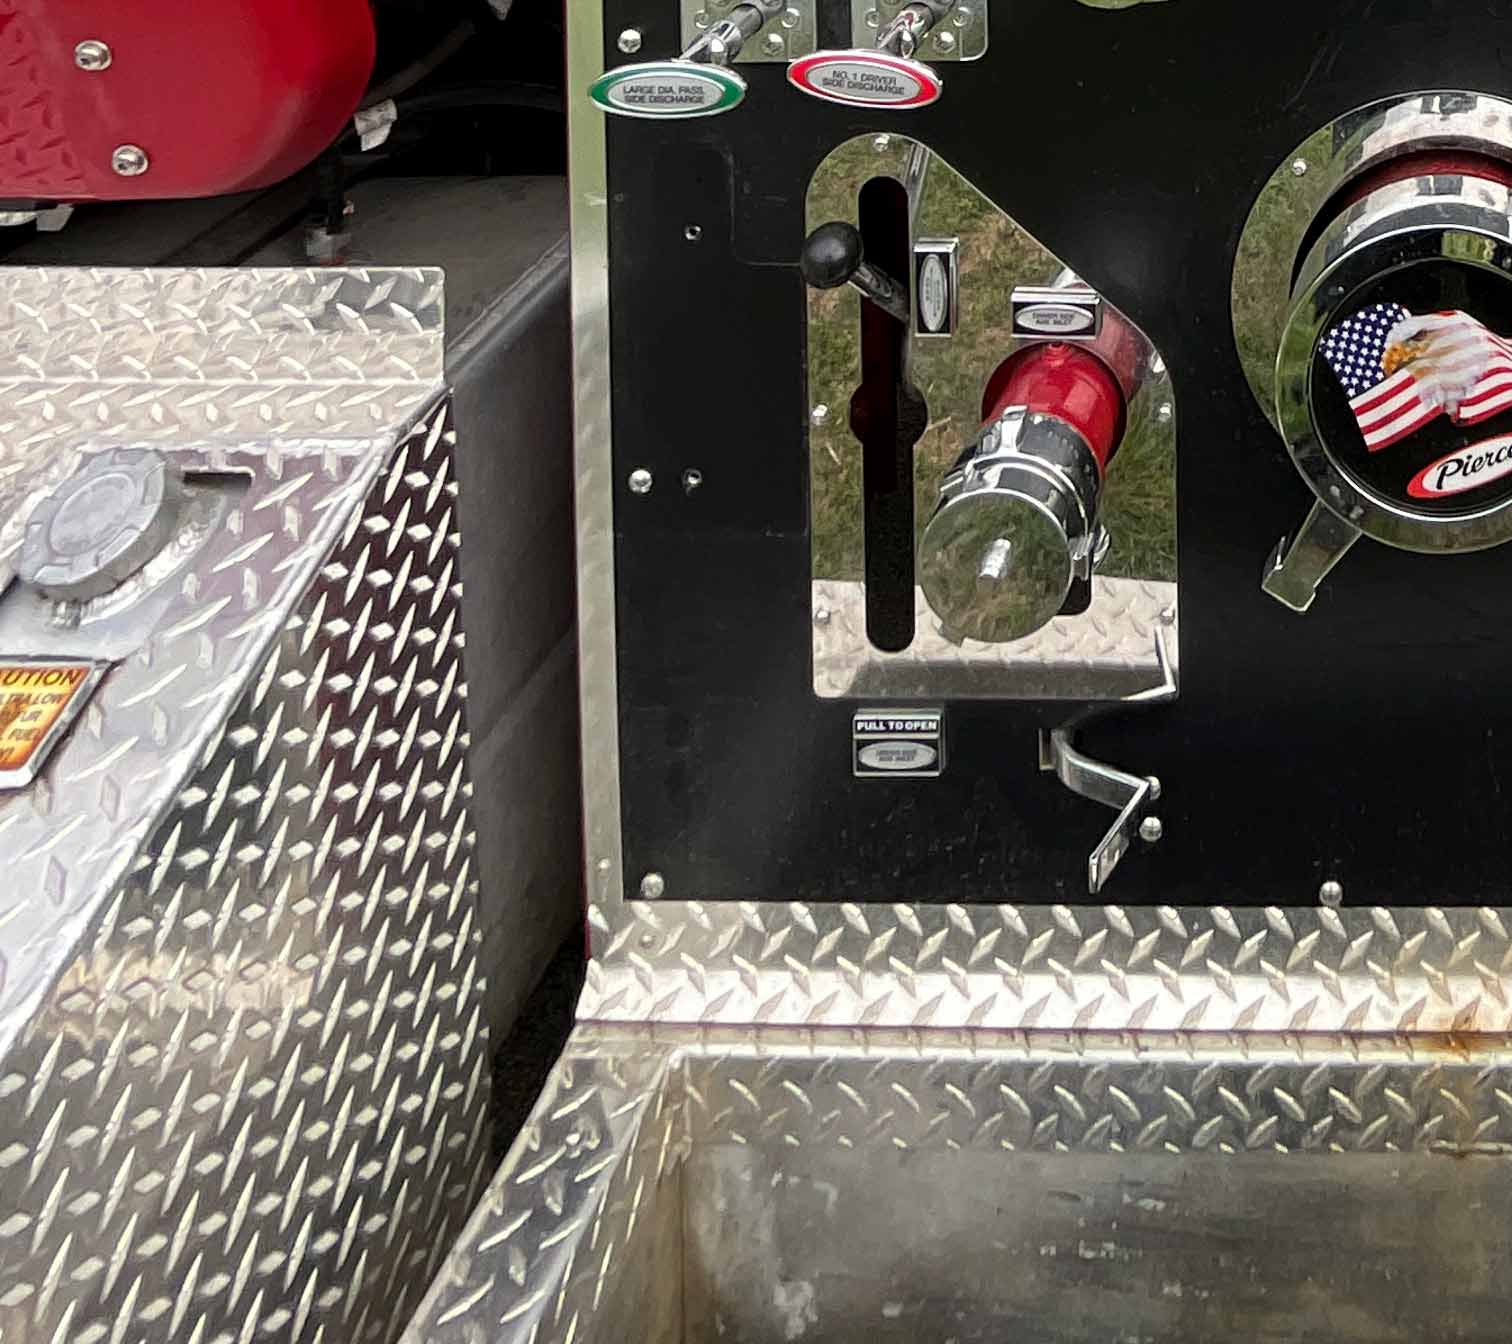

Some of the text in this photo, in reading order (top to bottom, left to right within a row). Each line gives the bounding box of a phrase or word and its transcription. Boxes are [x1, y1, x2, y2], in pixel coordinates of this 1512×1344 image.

[832, 70, 897, 85] NO. 1 DRIVER
[623, 86, 705, 95] LARGE DIA. PASS.
[822, 78, 904, 95] SIDE DISCHARGE
[625, 95, 705, 104] SIDE DISCHARGE
[857, 721, 937, 730] PULL TO OPEN
